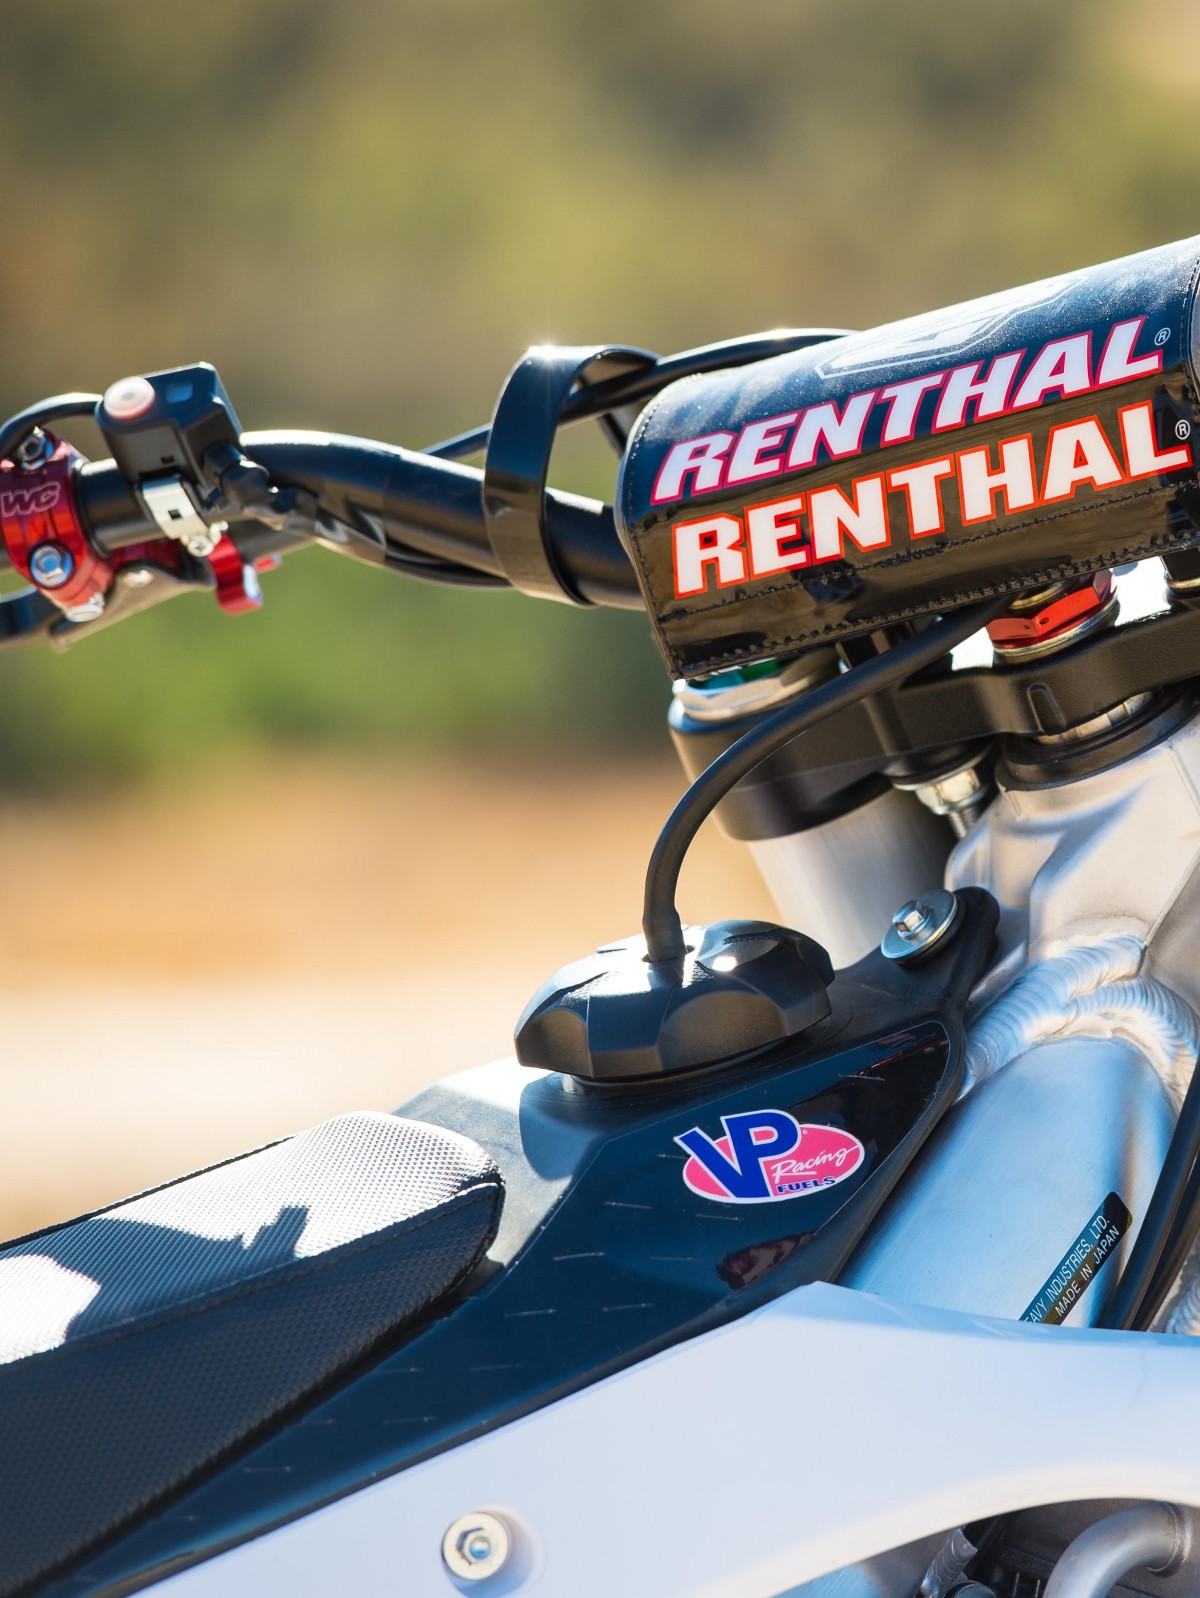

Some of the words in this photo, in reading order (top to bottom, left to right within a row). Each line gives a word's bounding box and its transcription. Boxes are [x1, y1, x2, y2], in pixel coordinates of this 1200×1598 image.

[674, 1110, 801, 1199] VP
[770, 1149, 859, 1184] Racing
[776, 1176, 837, 1194] FUELS
[1024, 1298, 1047, 1323] AVY
[1045, 1239, 1094, 1302] INDUSTRIES,
[1089, 1215, 1110, 1240] LTD.
[1054, 1280, 1081, 1316] MADE
[1080, 1264, 1093, 1281] IN
[1093, 1225, 1120, 1264] JAPAN
